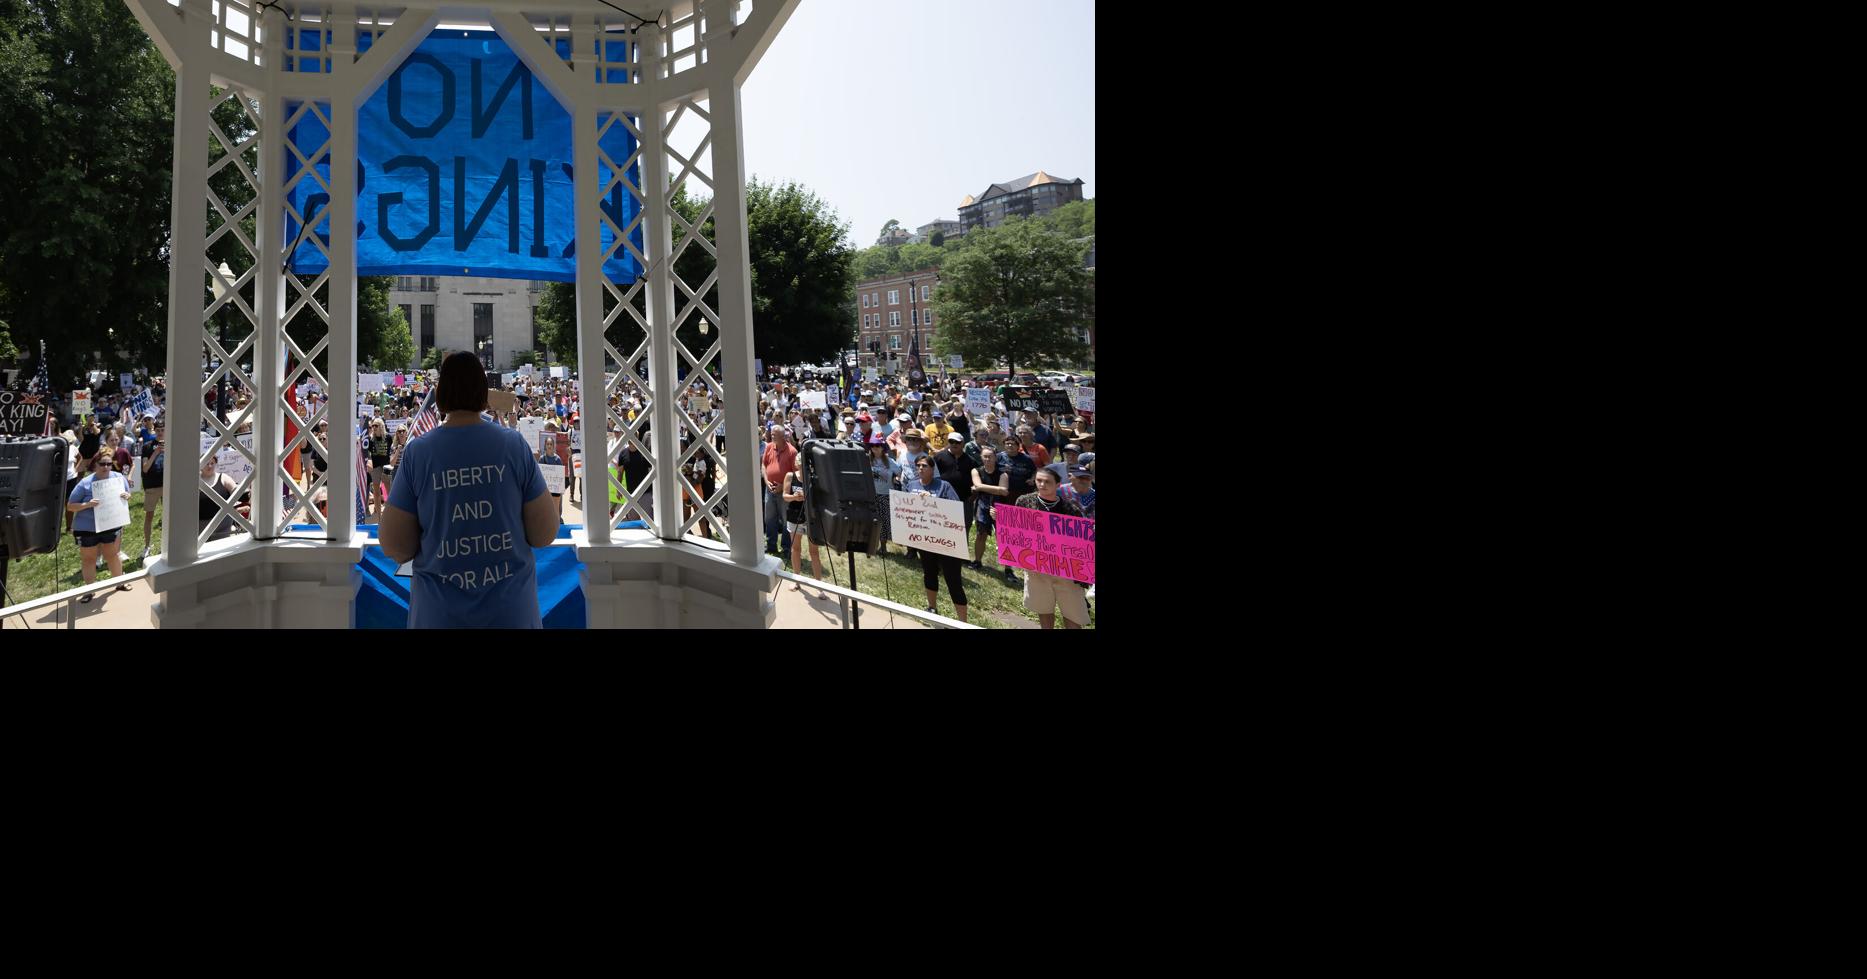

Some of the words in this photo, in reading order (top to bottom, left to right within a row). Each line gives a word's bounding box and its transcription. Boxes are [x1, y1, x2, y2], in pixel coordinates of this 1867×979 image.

[10, 404, 45, 419] KING
[1009, 399, 1021, 408] NO
[0, 418, 24, 433] AY!
[432, 464, 507, 491] LIBERTY
[451, 500, 493, 523] AND
[1049, 514, 1095, 542] RIGHTS
[436, 531, 513, 560] JUSTICE
[908, 533, 923, 542] NO
[924, 535, 956, 549] KINGS!
[1036, 533, 1056, 552] the
[482, 561, 514, 587] ALL
